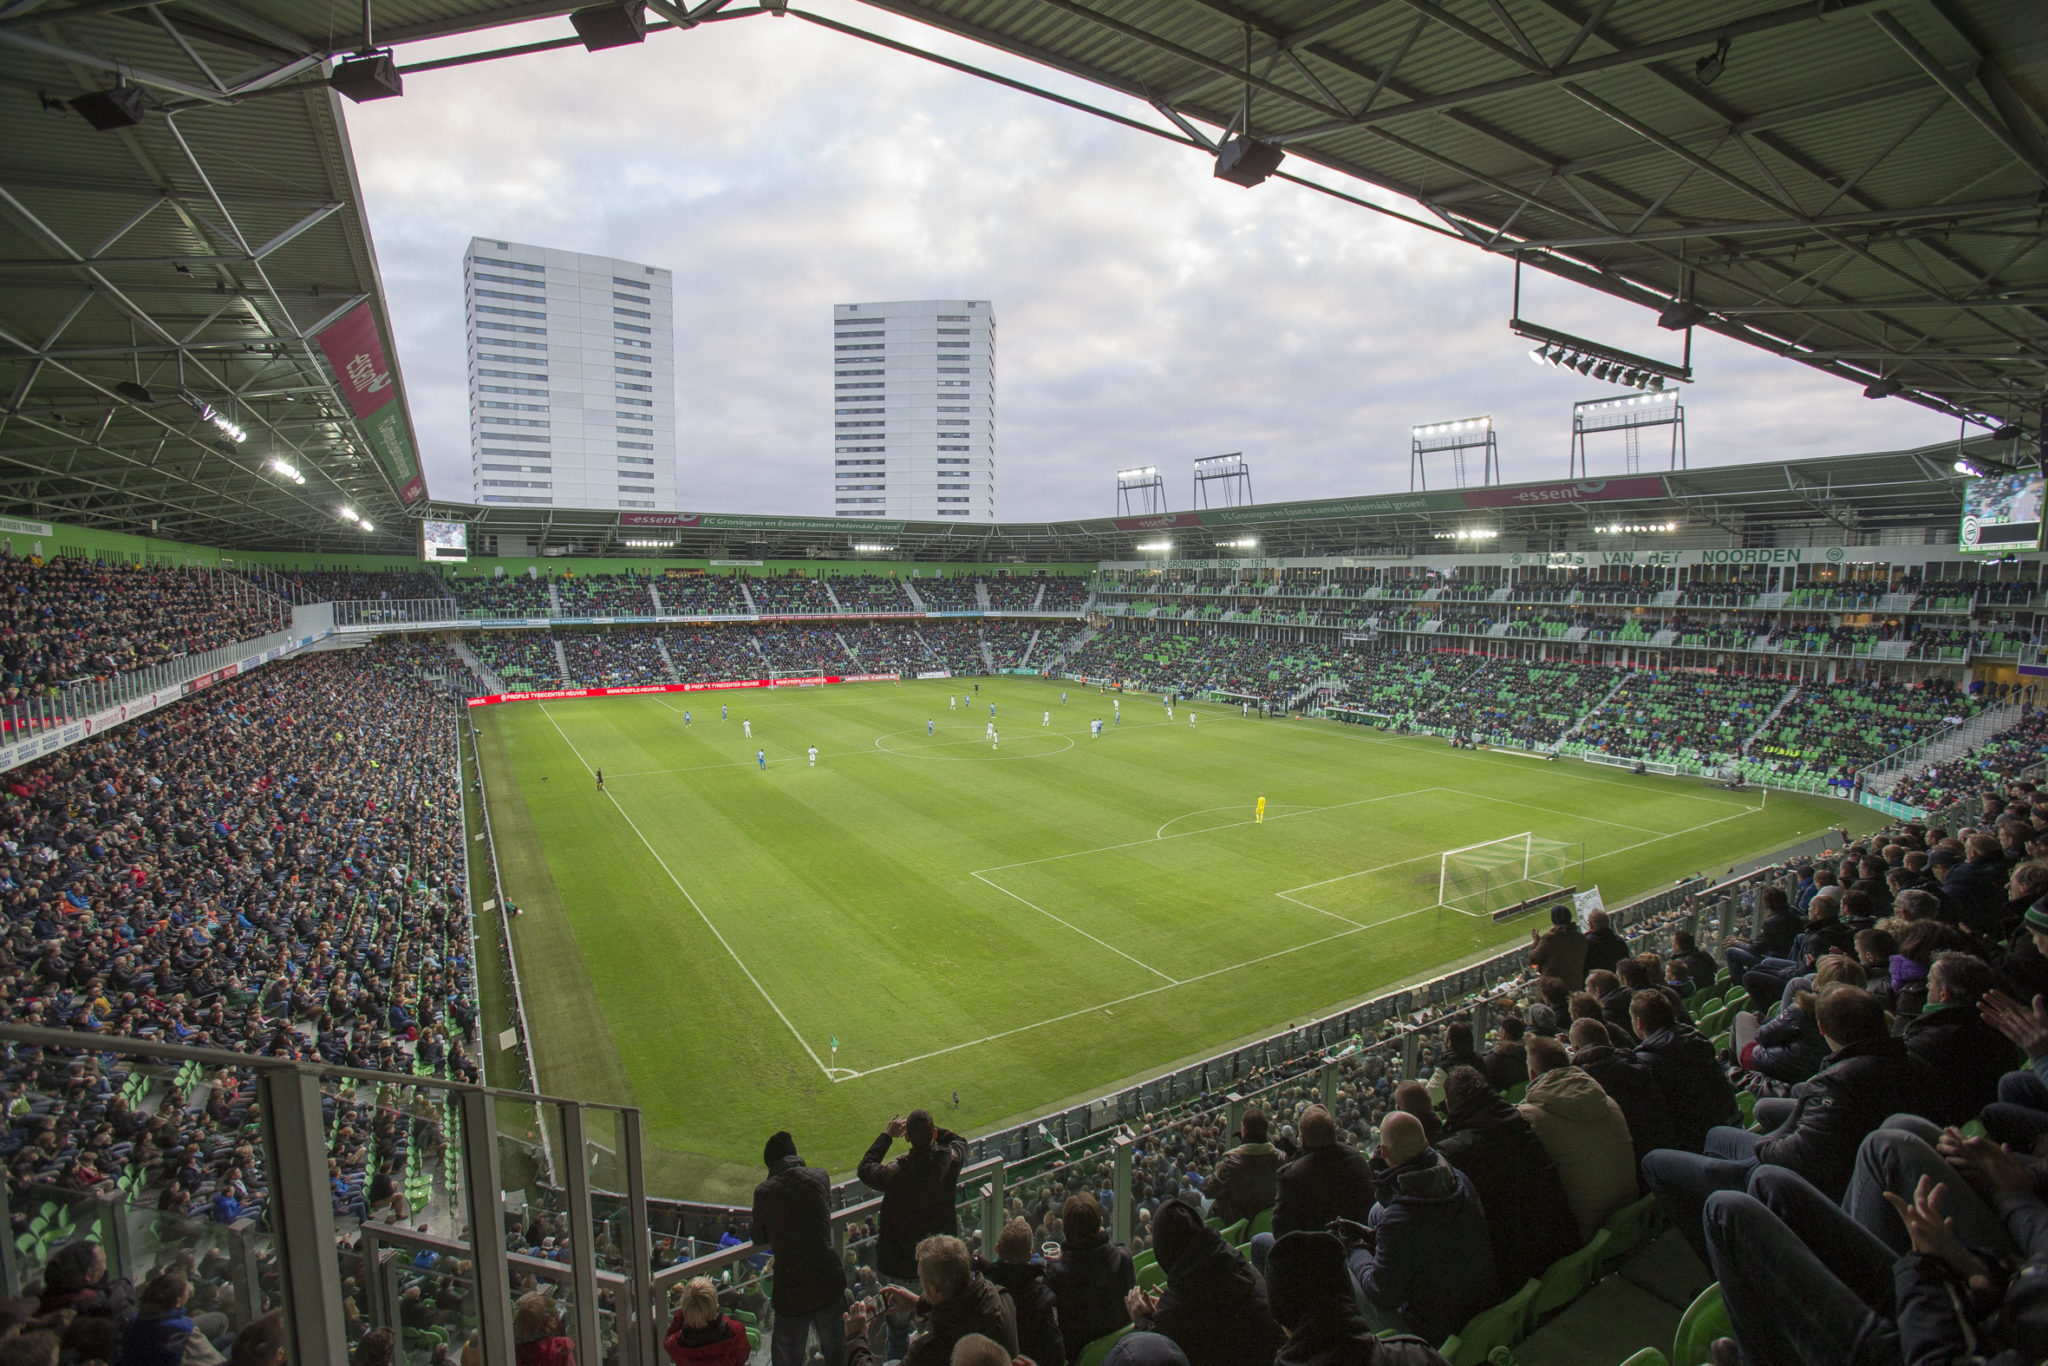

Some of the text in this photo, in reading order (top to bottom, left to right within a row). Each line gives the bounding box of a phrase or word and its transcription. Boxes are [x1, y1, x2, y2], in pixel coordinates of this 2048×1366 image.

[1519, 485, 1582, 501] essent
[633, 515, 678, 524] essent
[703, 517, 716, 525] FC
[716, 518, 764, 528] Groningen
[777, 519, 805, 528] Essent
[806, 521, 835, 529] samen
[835, 521, 873, 530] helemáál
[874, 523, 900, 532] groen!
[1139, 518, 1168, 528] essent
[1603, 551, 1634, 564] VAN
[1648, 551, 1683, 564] HET
[1702, 549, 1801, 563] NOORDEN
[1157, 559, 1267, 569] FC GRONINGEN SINDS 1971
[506, 693, 530, 701] PROFILE
[531, 690, 565, 699] TYRECENTER
